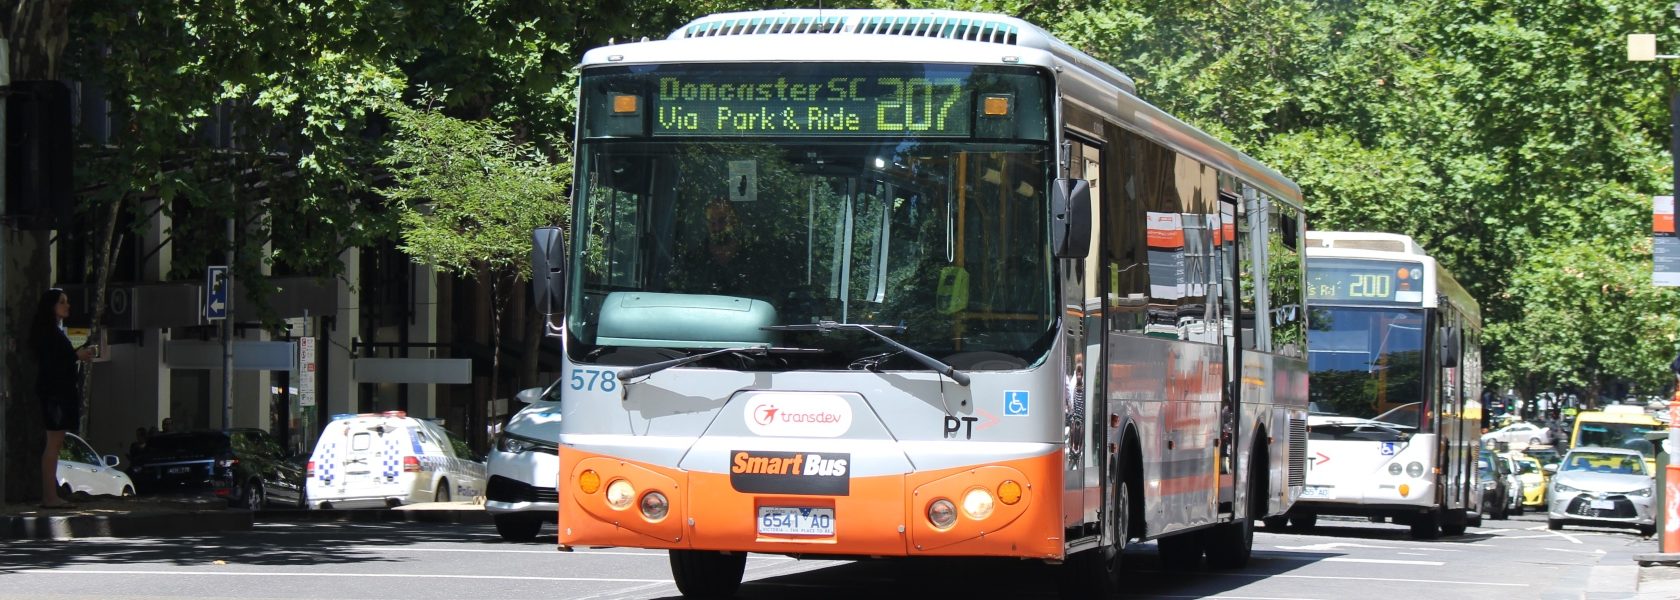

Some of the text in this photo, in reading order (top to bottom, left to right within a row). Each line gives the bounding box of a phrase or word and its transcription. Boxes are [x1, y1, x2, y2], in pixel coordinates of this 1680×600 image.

[659, 76, 867, 101] Doncaster SC
[876, 76, 962, 131] 207
[658, 105, 860, 131] Via Park & Ride
[1349, 274, 1390, 298] 200
[570, 368, 617, 393] 578
[781, 411, 842, 424] transdev
[943, 415, 979, 440] PT
[732, 451, 848, 477] Smart Bus
[763, 513, 798, 528] 6541
